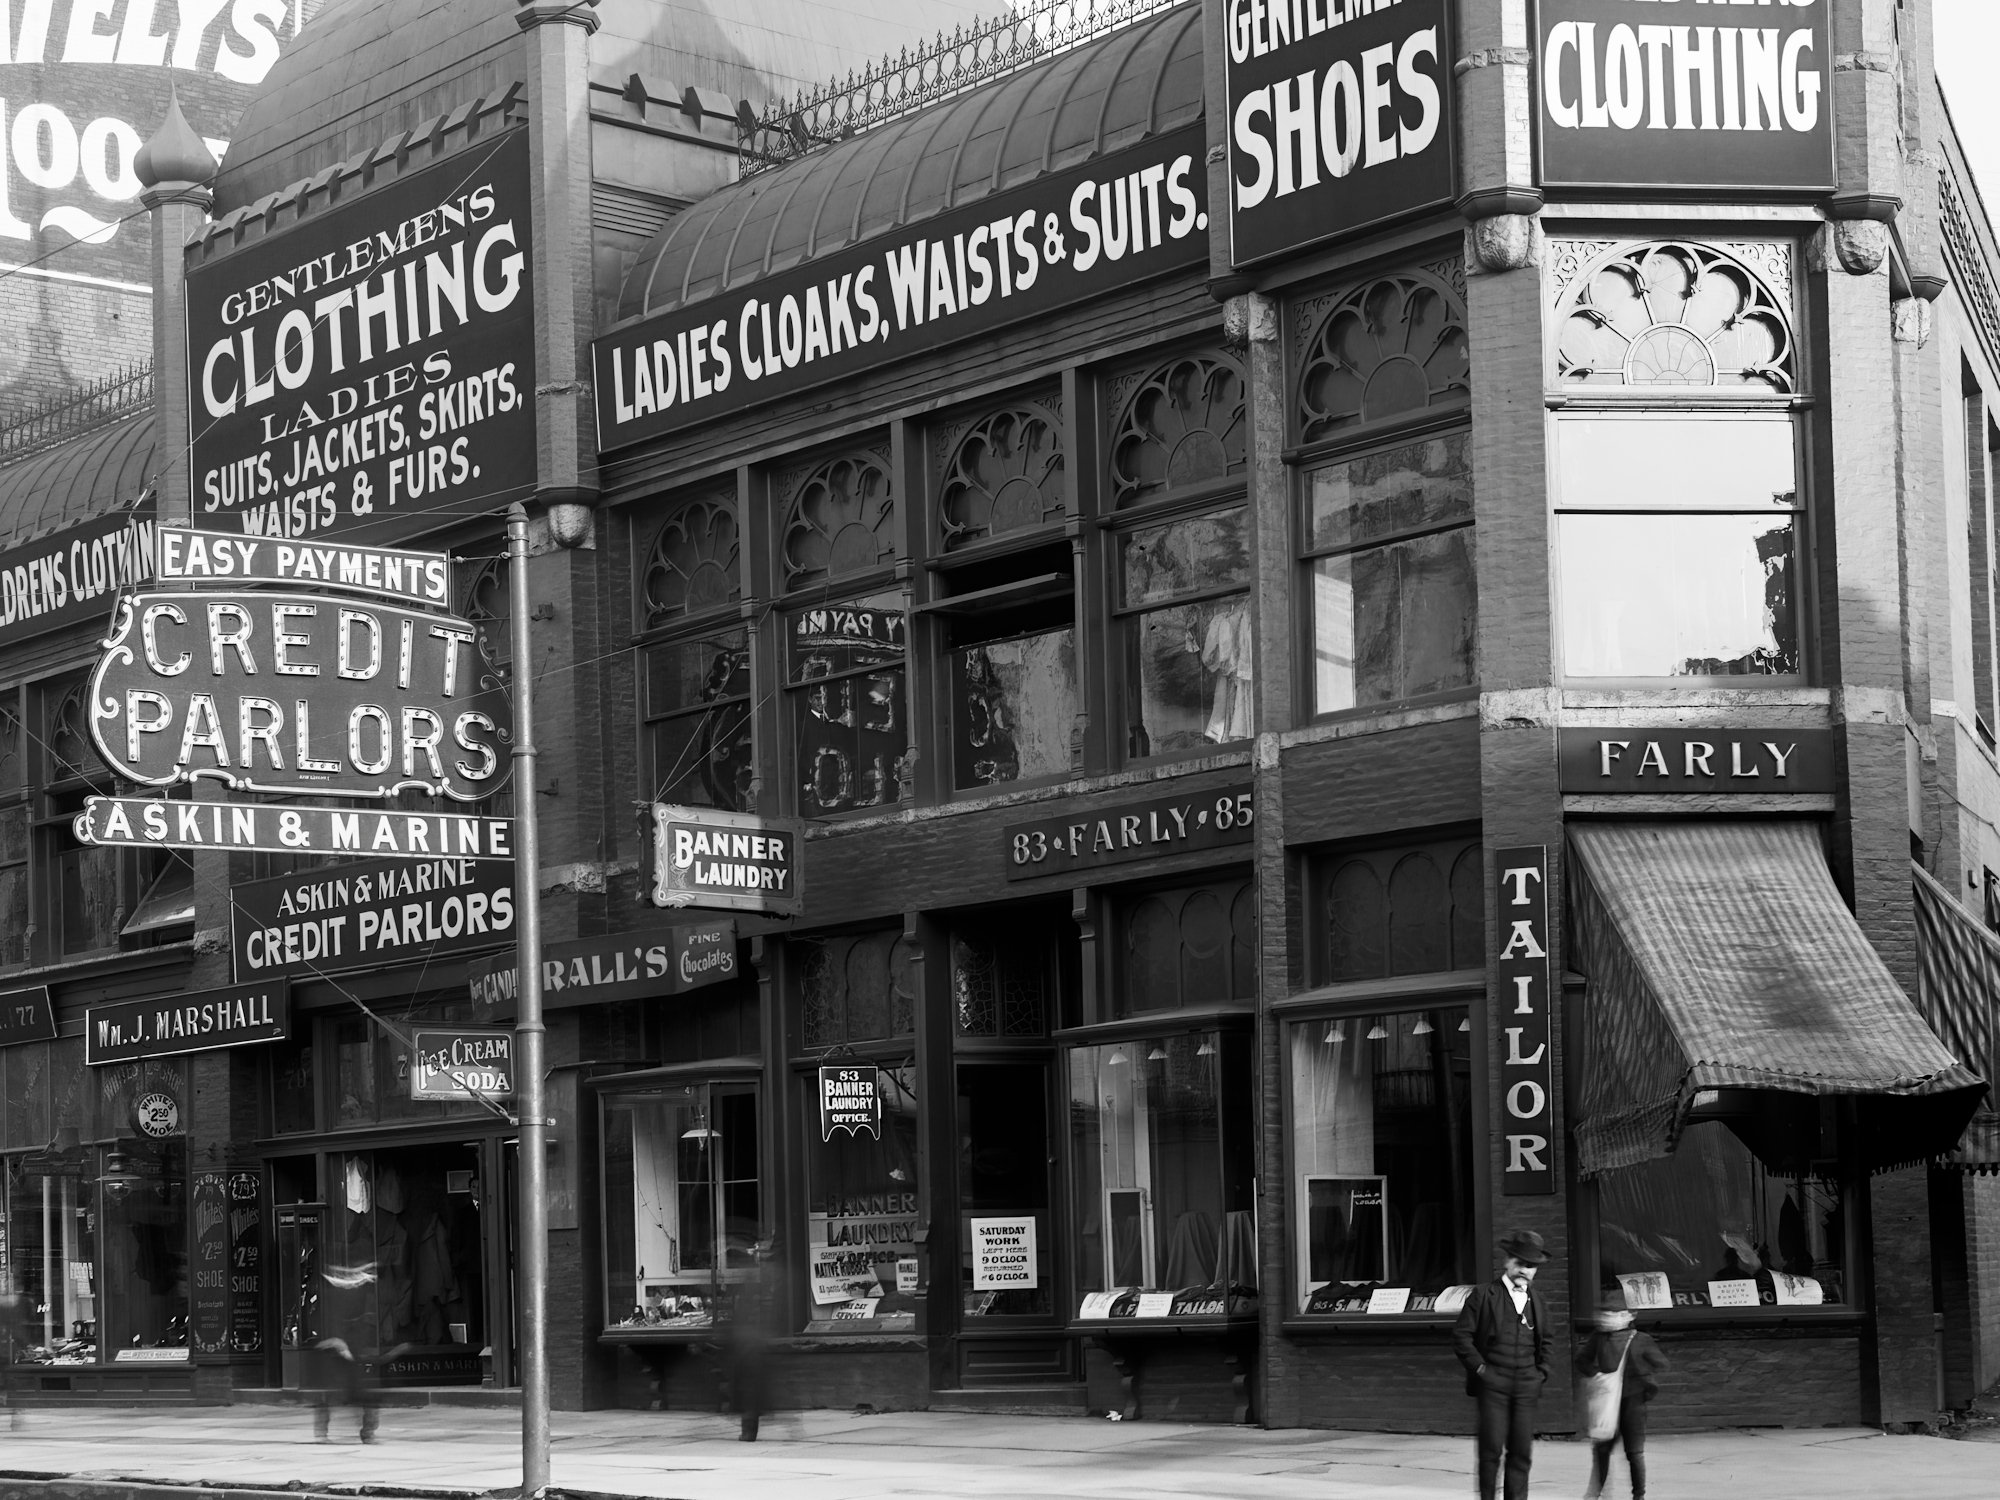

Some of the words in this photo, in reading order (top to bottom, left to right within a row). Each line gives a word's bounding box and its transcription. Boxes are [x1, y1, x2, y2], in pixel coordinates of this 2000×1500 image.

[1544, 20, 1821, 133] CLOTHING
[1233, 24, 1441, 212] SHOES
[220, 184, 496, 325] GENTLEMENS
[612, 319, 731, 425] LADIES
[738, 264, 890, 381] CLOAKS,
[885, 209, 1039, 331] WAISTS
[1043, 212, 1067, 264] &
[1069, 155, 1208, 272] SUITS.
[202, 220, 524, 418] CLOTHING
[260, 349, 452, 444] LADIES
[204, 451, 279, 513] SUITS,
[283, 404, 411, 487] JACKETS,
[419, 362, 523, 441] SKIRTS,
[241, 482, 337, 538] WAISTS
[351, 470, 373, 516] &
[389, 436, 480, 506] FURS.
[162, 534, 260, 578] EASY
[276, 545, 445, 599] PAYMENTS
[0, 551, 67, 627] DRENS
[140, 601, 475, 698] CREDIT
[126, 688, 497, 781] PARLORS
[1599, 740, 1797, 779] FARLY
[104, 802, 256, 846] ASKIN
[279, 811, 310, 848] &
[331, 813, 510, 856] MARINE
[1012, 831, 1048, 865] 83
[1068, 803, 1193, 858] FARLY
[1214, 793, 1254, 830] 85
[675, 829, 784, 869] BANNER
[277, 878, 349, 918] ASKIN
[354, 875, 372, 903] &
[379, 859, 476, 900] MARINE
[695, 861, 788, 890] LAUNDRY
[247, 916, 346, 969] CREDIT
[359, 888, 514, 952] PARLORS
[688, 932, 721, 946] FINE
[680, 948, 734, 983] Chocolates
[16, 1005, 35, 1026] 77
[131, 1015, 150, 1043] J.
[156, 995, 274, 1040] MARSHALL
[1500, 867, 1547, 1172] TAILOR
[420, 1048, 451, 1090] ICE
[451, 1038, 508, 1069] CREAM
[451, 1071, 510, 1091] SODA
[839, 1070, 859, 1081] 83
[825, 1079, 873, 1096] BANNER
[825, 1096, 873, 1110] LAUNDRY
[143, 1122, 173, 1135] SHOE
[832, 1113, 871, 1123] OFFICE.
[827, 1192, 917, 1217] BANNER
[827, 1221, 917, 1247] LAUNDRY
[980, 1226, 1026, 1236] SATURDAY
[985, 1237, 1020, 1246] WORK
[197, 1270, 224, 1287] SHOE
[231, 1275, 259, 1293] SHOE
[1176, 1300, 1225, 1315] TAILOR
[1672, 1293, 1713, 1305] RLY
[389, 1361, 430, 1372] ASKIN
